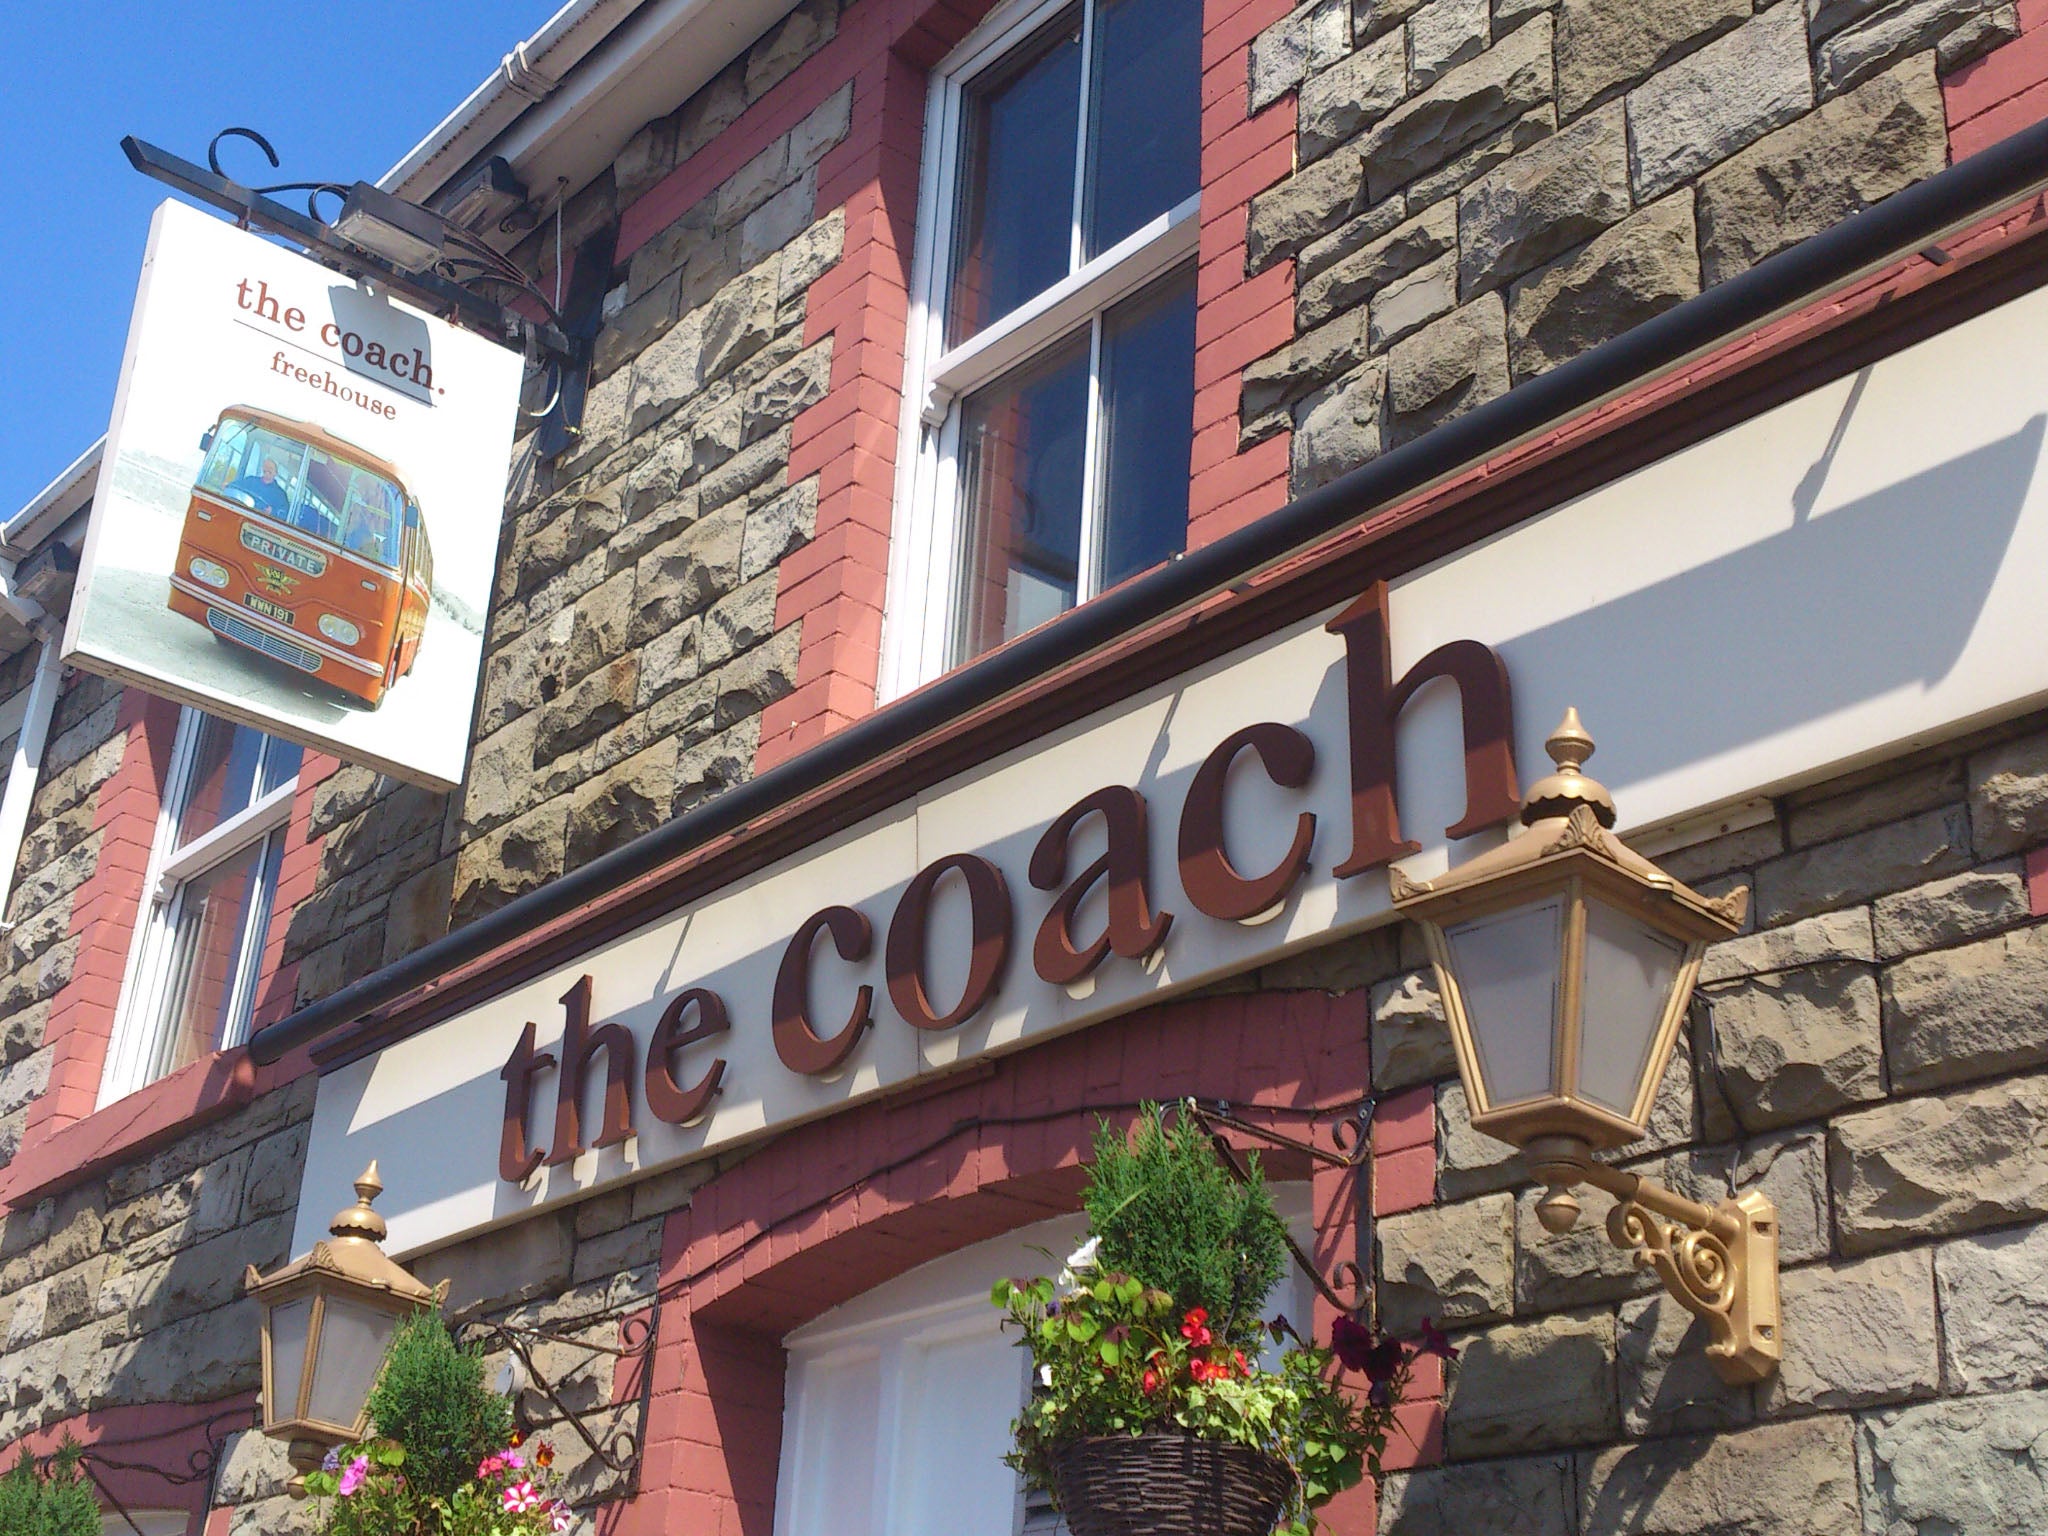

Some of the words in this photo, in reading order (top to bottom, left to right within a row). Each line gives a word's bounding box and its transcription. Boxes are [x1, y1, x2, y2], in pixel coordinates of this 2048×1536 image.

[235, 277, 306, 331] the
[320, 322, 446, 395] coach.
[270, 351, 397, 421] freehouse
[251, 535, 316, 573] PRIVATE
[273, 606, 289, 622] 191
[499, 974, 730, 1183] the
[772, 579, 1521, 1075] coach
